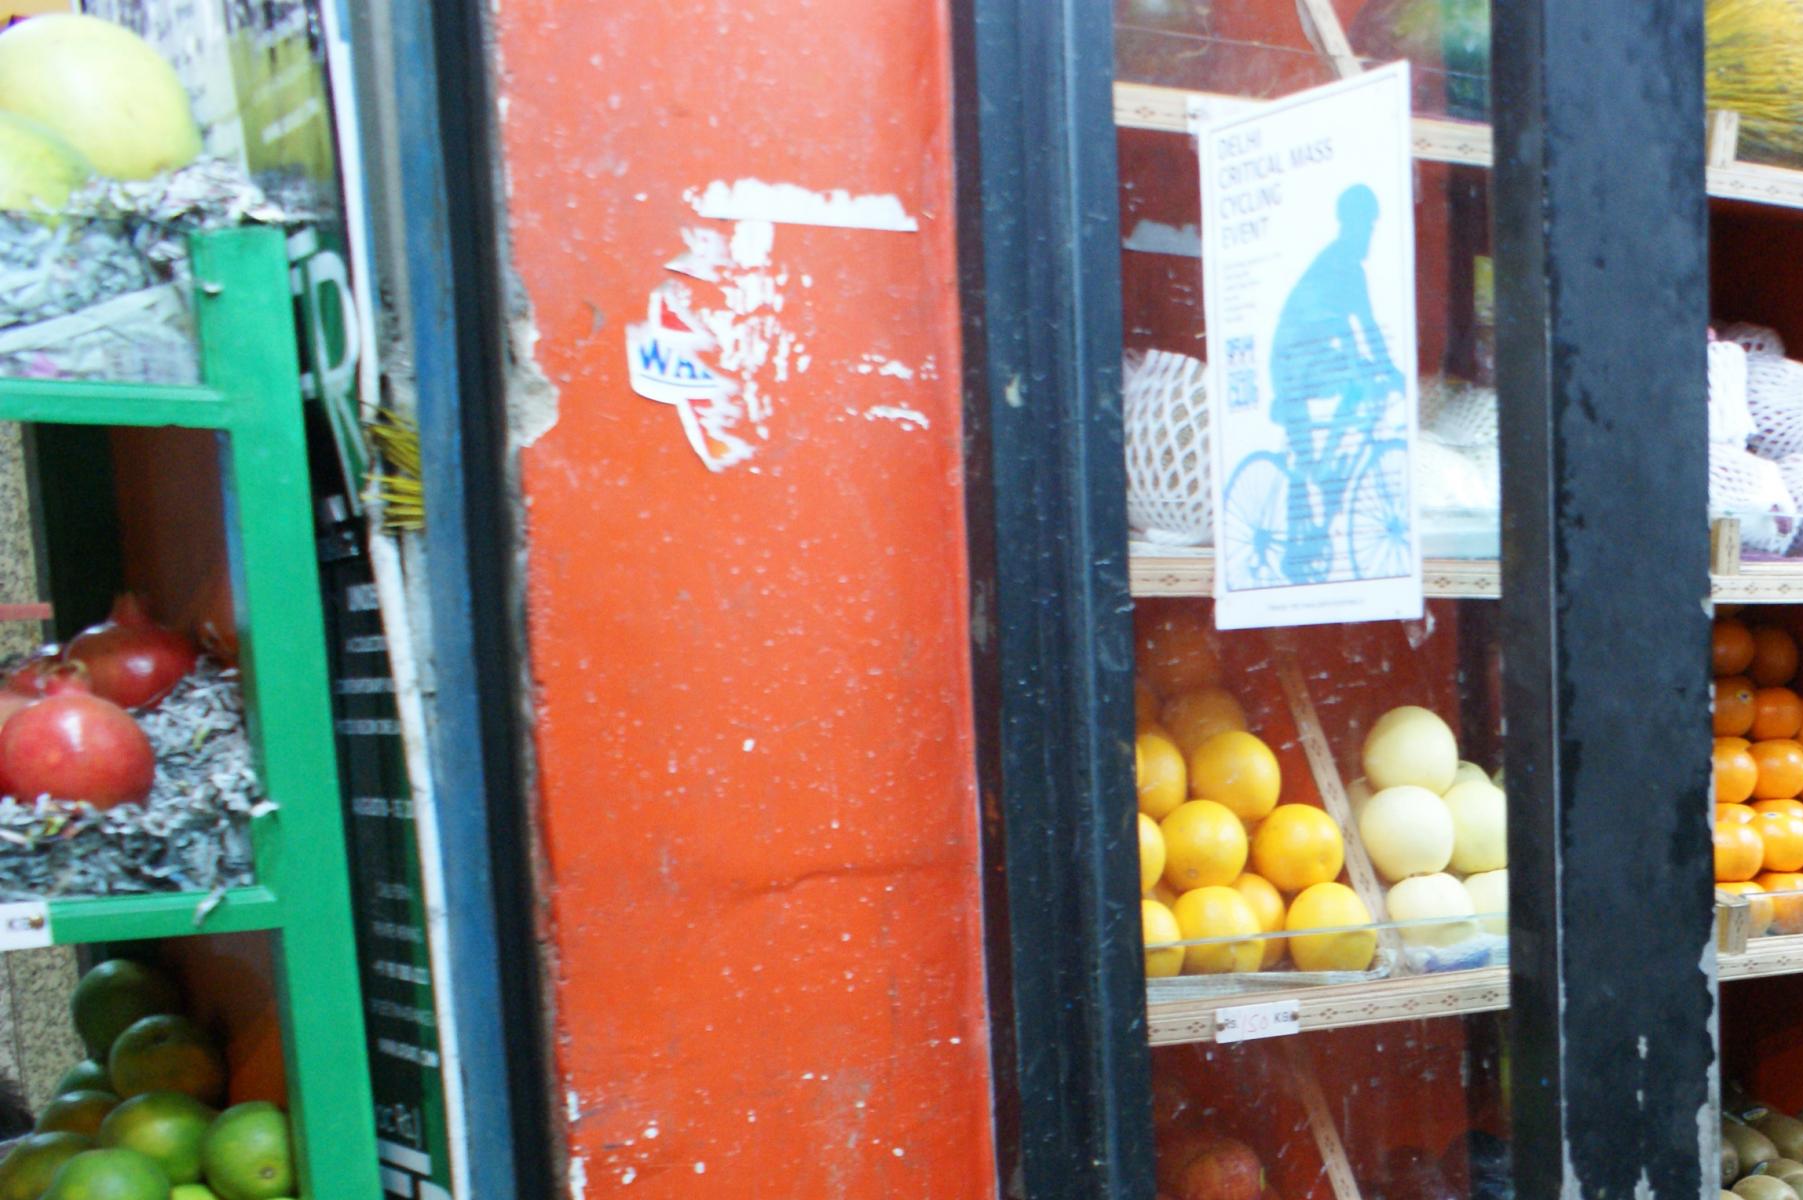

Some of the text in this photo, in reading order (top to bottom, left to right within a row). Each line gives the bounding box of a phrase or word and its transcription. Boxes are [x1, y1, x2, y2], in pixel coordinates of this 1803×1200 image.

[1217, 127, 1262, 161] DELHI
[1217, 137, 1334, 190] CRITICAL MASS
[1219, 182, 1283, 221] CYCLING
[1221, 216, 1270, 250] EVENT
